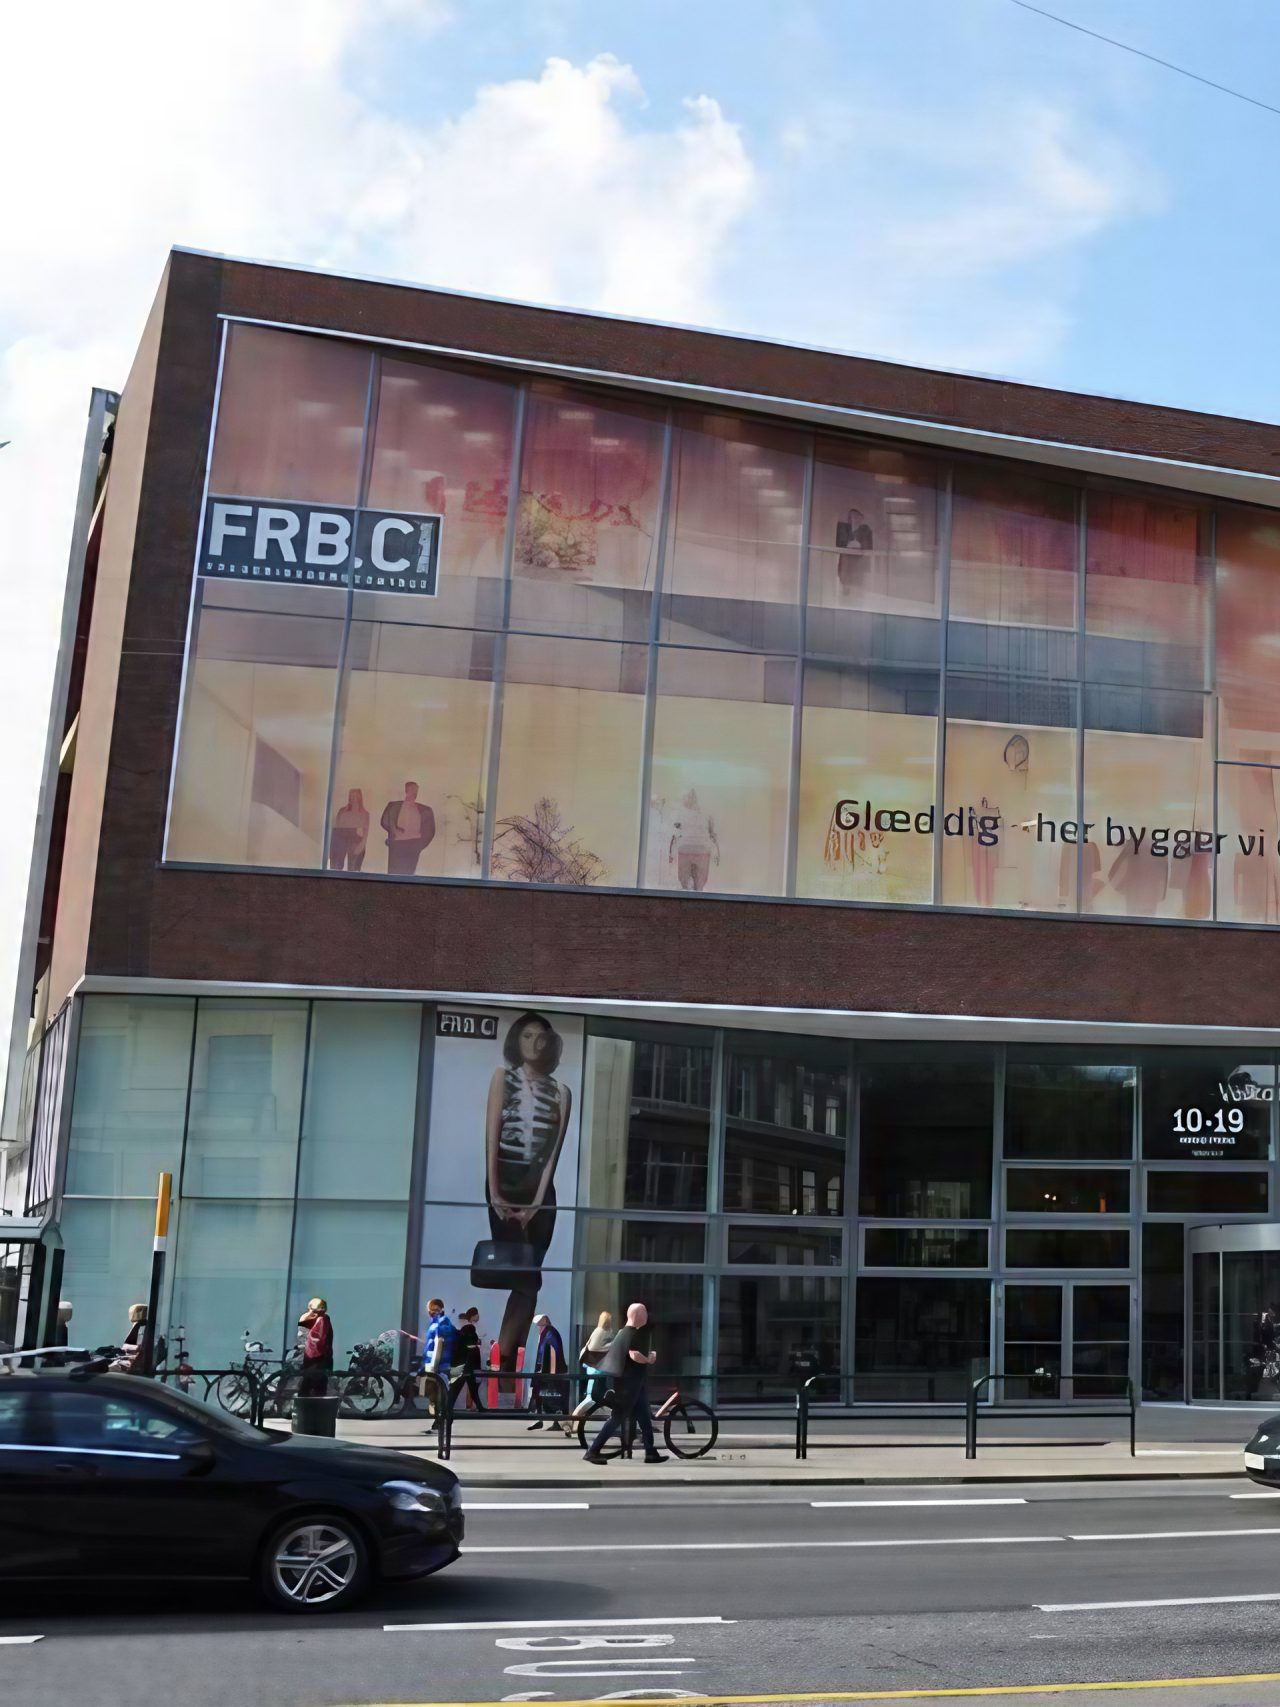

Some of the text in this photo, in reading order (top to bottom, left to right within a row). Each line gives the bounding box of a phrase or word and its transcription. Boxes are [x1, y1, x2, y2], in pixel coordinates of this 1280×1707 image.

[208, 502, 414, 572] FRB.C
[943, 806, 1000, 846] dig
[1037, 813, 1094, 844] her
[1106, 816, 1228, 859] bygger
[1238, 829, 1265, 857] vi
